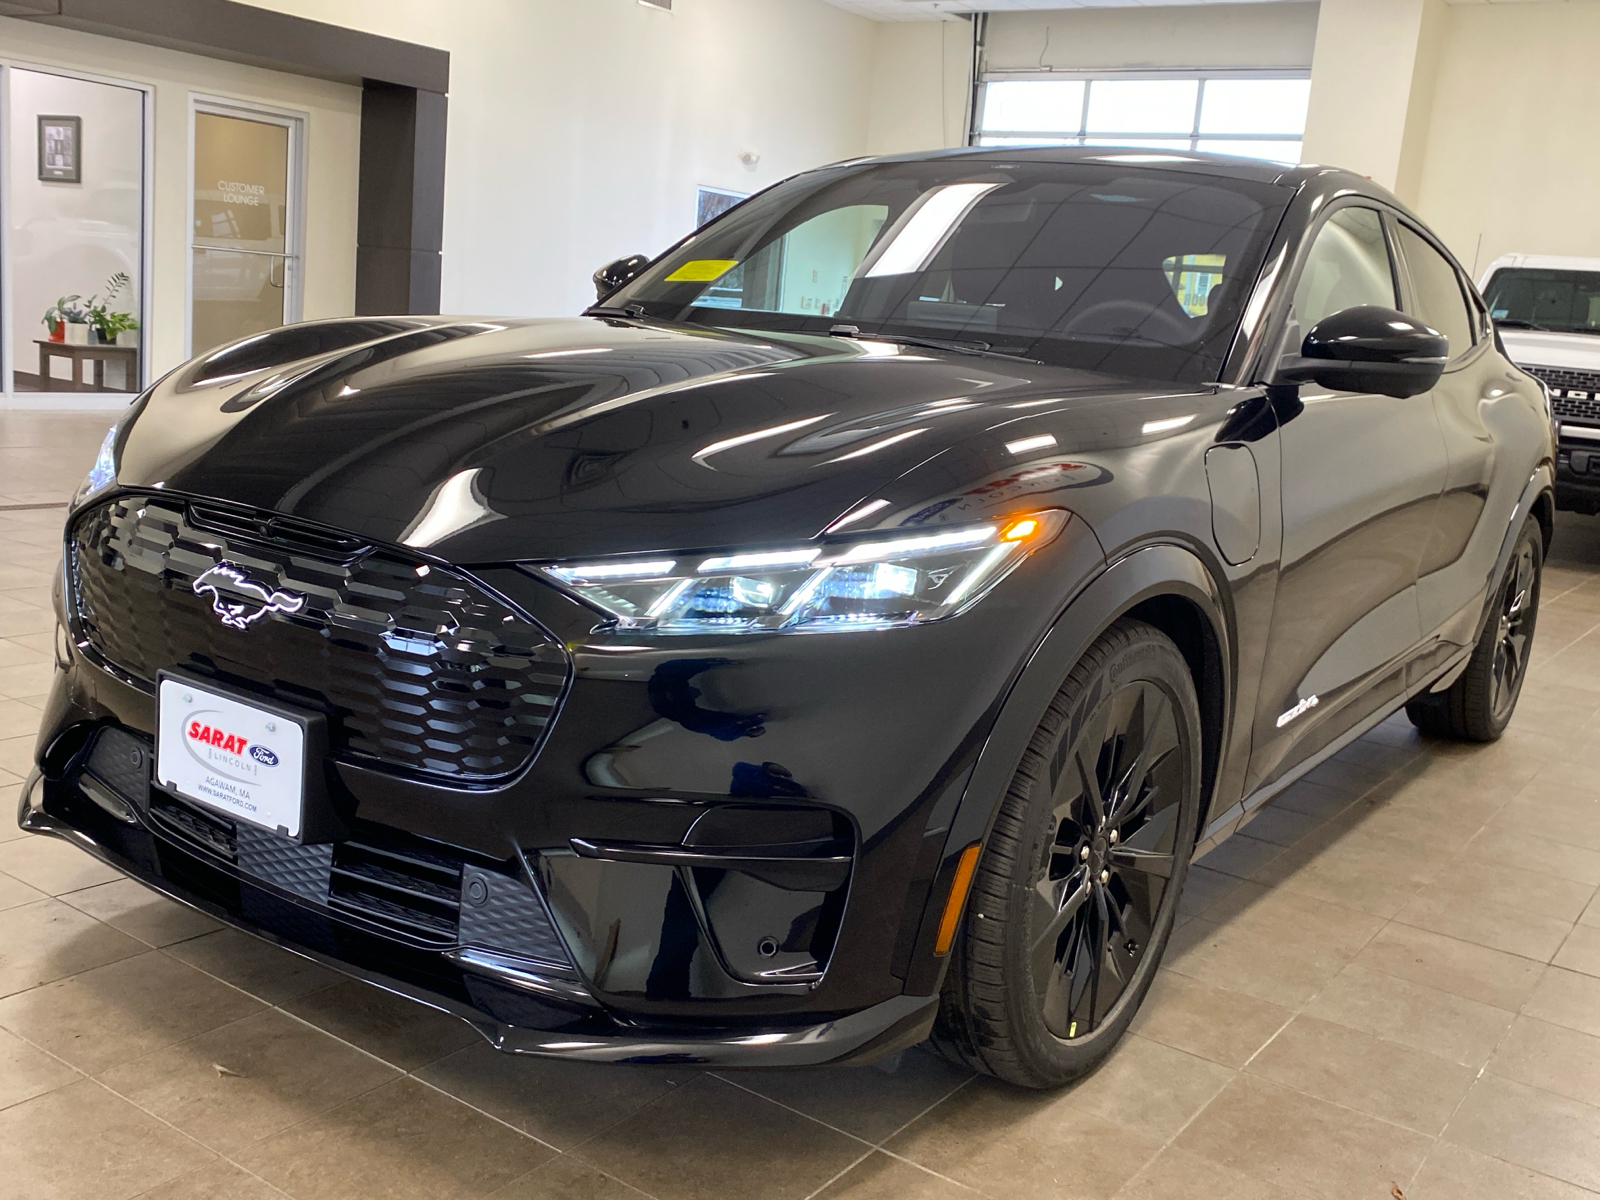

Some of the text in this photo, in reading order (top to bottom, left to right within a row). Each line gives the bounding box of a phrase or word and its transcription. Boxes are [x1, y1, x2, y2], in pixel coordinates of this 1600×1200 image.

[217, 180, 265, 195] CUSTOMER
[223, 193, 259, 206] LOUNGE
[188, 721, 248, 756] SARAT
[214, 752, 251, 772] LINCOLN
[252, 747, 276, 766] Ford
[198, 784, 257, 811] WWW.SARATFORD.COM
[205, 776, 251, 800] AGAWAM, MA
